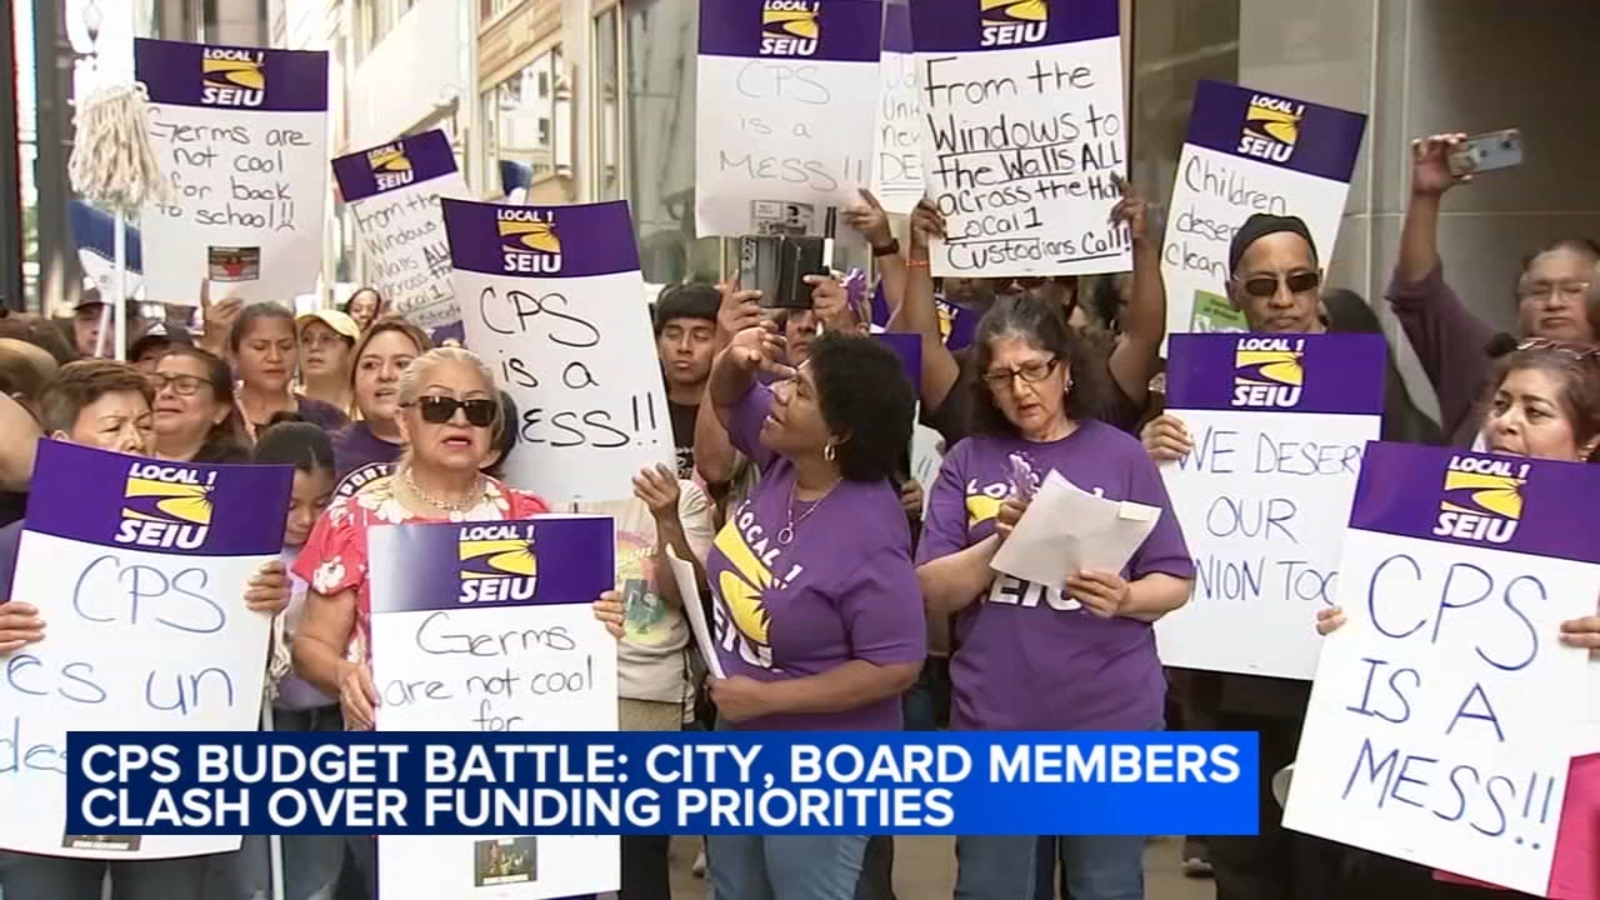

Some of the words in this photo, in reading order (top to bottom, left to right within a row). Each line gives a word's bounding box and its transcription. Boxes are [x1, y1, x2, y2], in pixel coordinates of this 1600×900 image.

[763, 0, 808, 11] LOCAL
[814, 2, 820, 12] 1
[760, 39, 817, 56] SEIU
[981, 22, 1047, 46] SEIU
[204, 48, 252, 61] LOCAL
[201, 88, 264, 106] SEIU
[736, 61, 831, 105] CPS
[924, 57, 1017, 107] From
[1028, 60, 1095, 94] the
[1250, 95, 1292, 114] LOCAL
[146, 107, 251, 146] Germs
[265, 129, 312, 147] are
[740, 114, 773, 135] is
[793, 123, 813, 139] a
[927, 113, 1080, 152] Windows
[1085, 104, 1121, 138] to
[173, 145, 219, 168] not
[233, 150, 283, 173] cool
[1238, 136, 1294, 163] SEIU
[375, 170, 414, 191] SEIU
[932, 156, 998, 190] the
[1000, 147, 1076, 180] Walls
[1081, 142, 1124, 172] ALL
[170, 171, 213, 200] for
[230, 175, 293, 201] back
[937, 185, 1032, 216] across
[1036, 180, 1088, 201] the
[1087, 176, 1121, 201] Ha
[1185, 155, 1287, 214] Children
[155, 203, 183, 218] to
[497, 209, 541, 222] LOCAL
[546, 211, 553, 222] 1
[1024, 206, 1043, 229] 1
[504, 253, 561, 273] SEIU
[947, 239, 1075, 270] Custodians
[1081, 228, 1131, 255] Call!
[1164, 241, 1227, 279] Clean
[480, 287, 601, 347] CPS
[1238, 338, 1289, 352] LOCAL
[1296, 339, 1305, 352] 1
[498, 349, 539, 388] is
[562, 361, 600, 389] a
[1231, 385, 1302, 408] SEIU
[518, 391, 658, 448] ESS!!
[129, 462, 199, 485] LOCAL
[204, 470, 218, 486] 1
[1449, 455, 1512, 477] LOCAL
[1518, 464, 1531, 479] 1
[115, 520, 210, 550] SEIU
[460, 526, 518, 541] LOCAL
[526, 525, 534, 540] 1
[1206, 496, 1300, 544] OUR
[1433, 512, 1518, 544] SEIU
[73, 554, 226, 634] CPS
[459, 577, 536, 603] SEIU
[989, 571, 1083, 611] EIU
[1368, 554, 1548, 672] CPS
[415, 611, 576, 658] Germs
[712, 594, 773, 669] EIU
[6, 653, 107, 704] es
[145, 667, 234, 716] un
[384, 680, 453, 708] are
[466, 668, 521, 697] not
[530, 656, 594, 696] cool
[1346, 657, 1421, 724] IS
[1445, 682, 1505, 742] A
[1341, 738, 1556, 850] MESS!!
